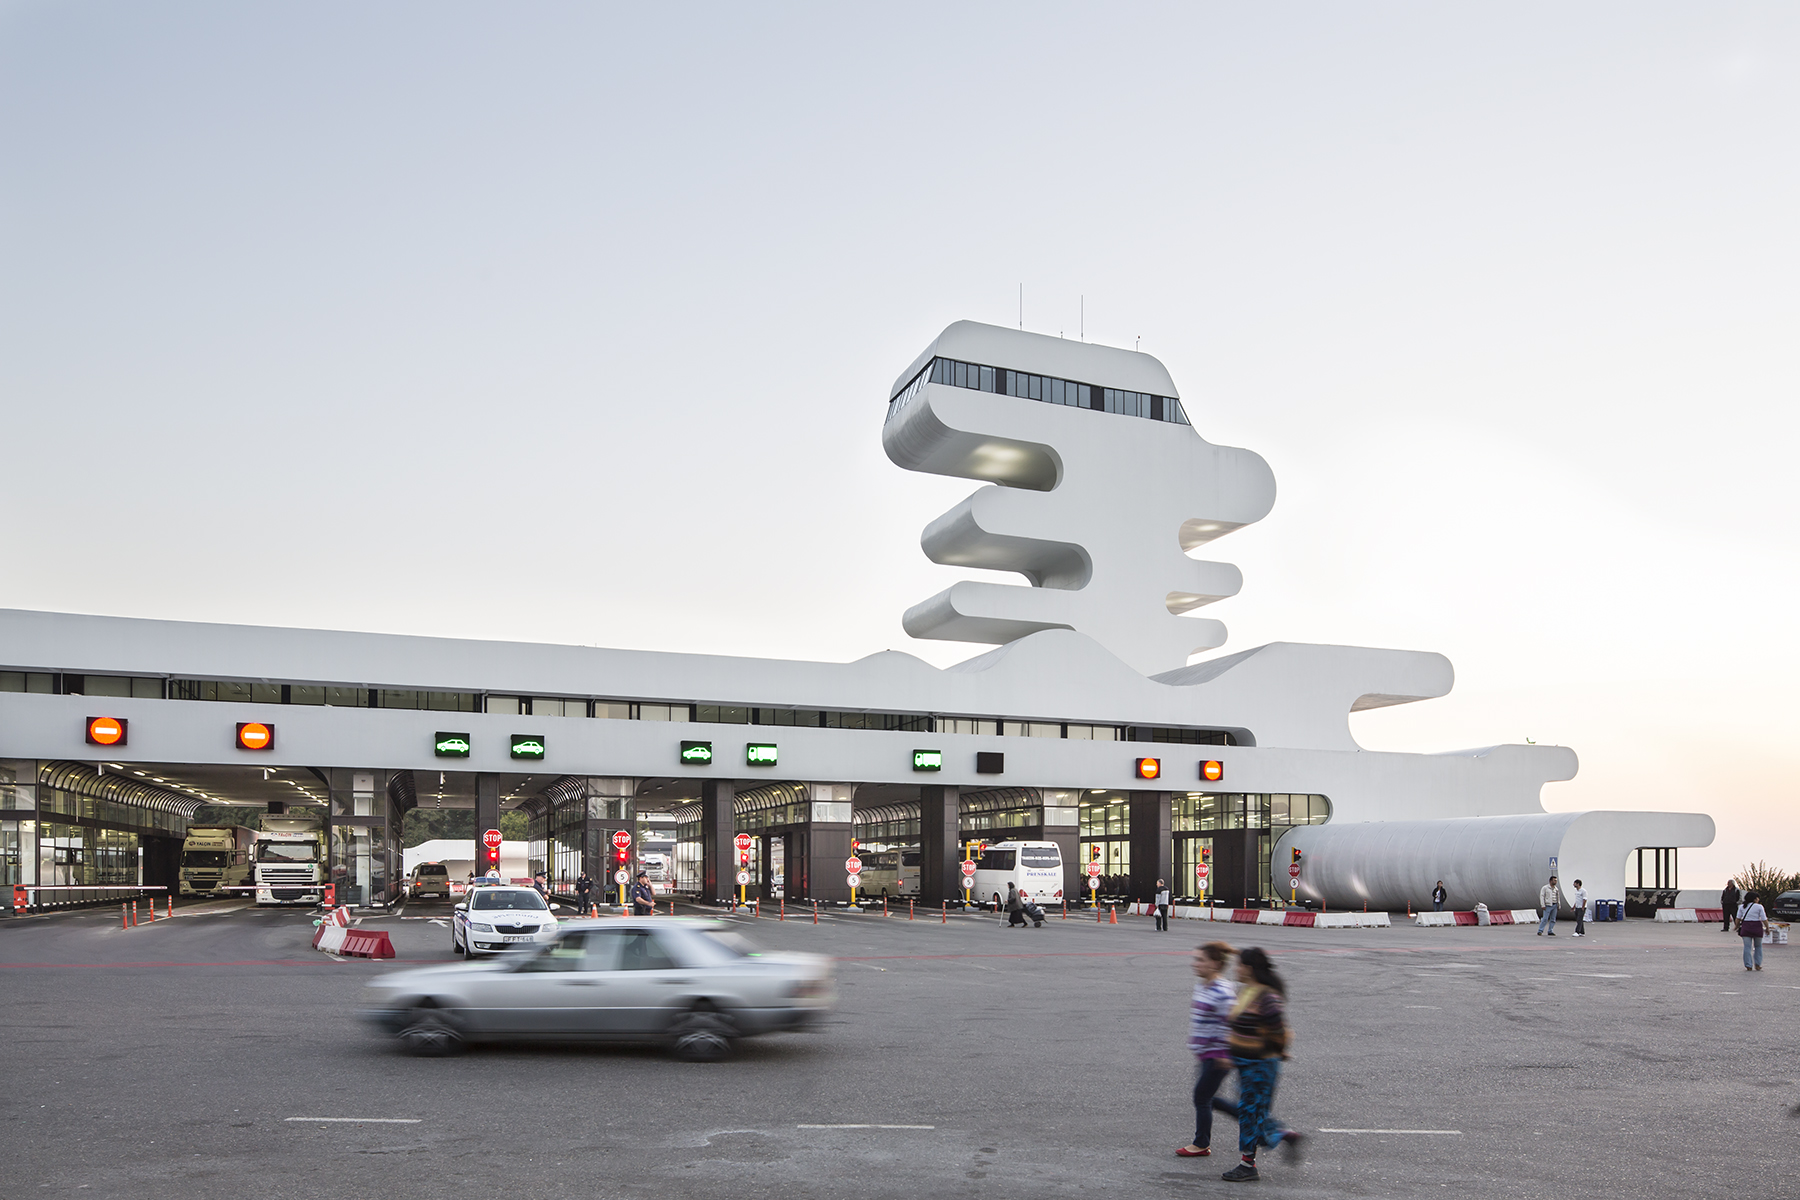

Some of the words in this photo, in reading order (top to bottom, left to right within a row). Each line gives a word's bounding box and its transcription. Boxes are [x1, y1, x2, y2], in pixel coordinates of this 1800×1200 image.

[484, 833, 502, 842] STOP
[613, 835, 631, 844] STOP
[735, 838, 752, 846] STOP
[846, 861, 862, 869] STOP
[962, 863, 976, 871] STOP
[1087, 865, 1101, 873] STOP
[1196, 866, 1210, 874] STOP
